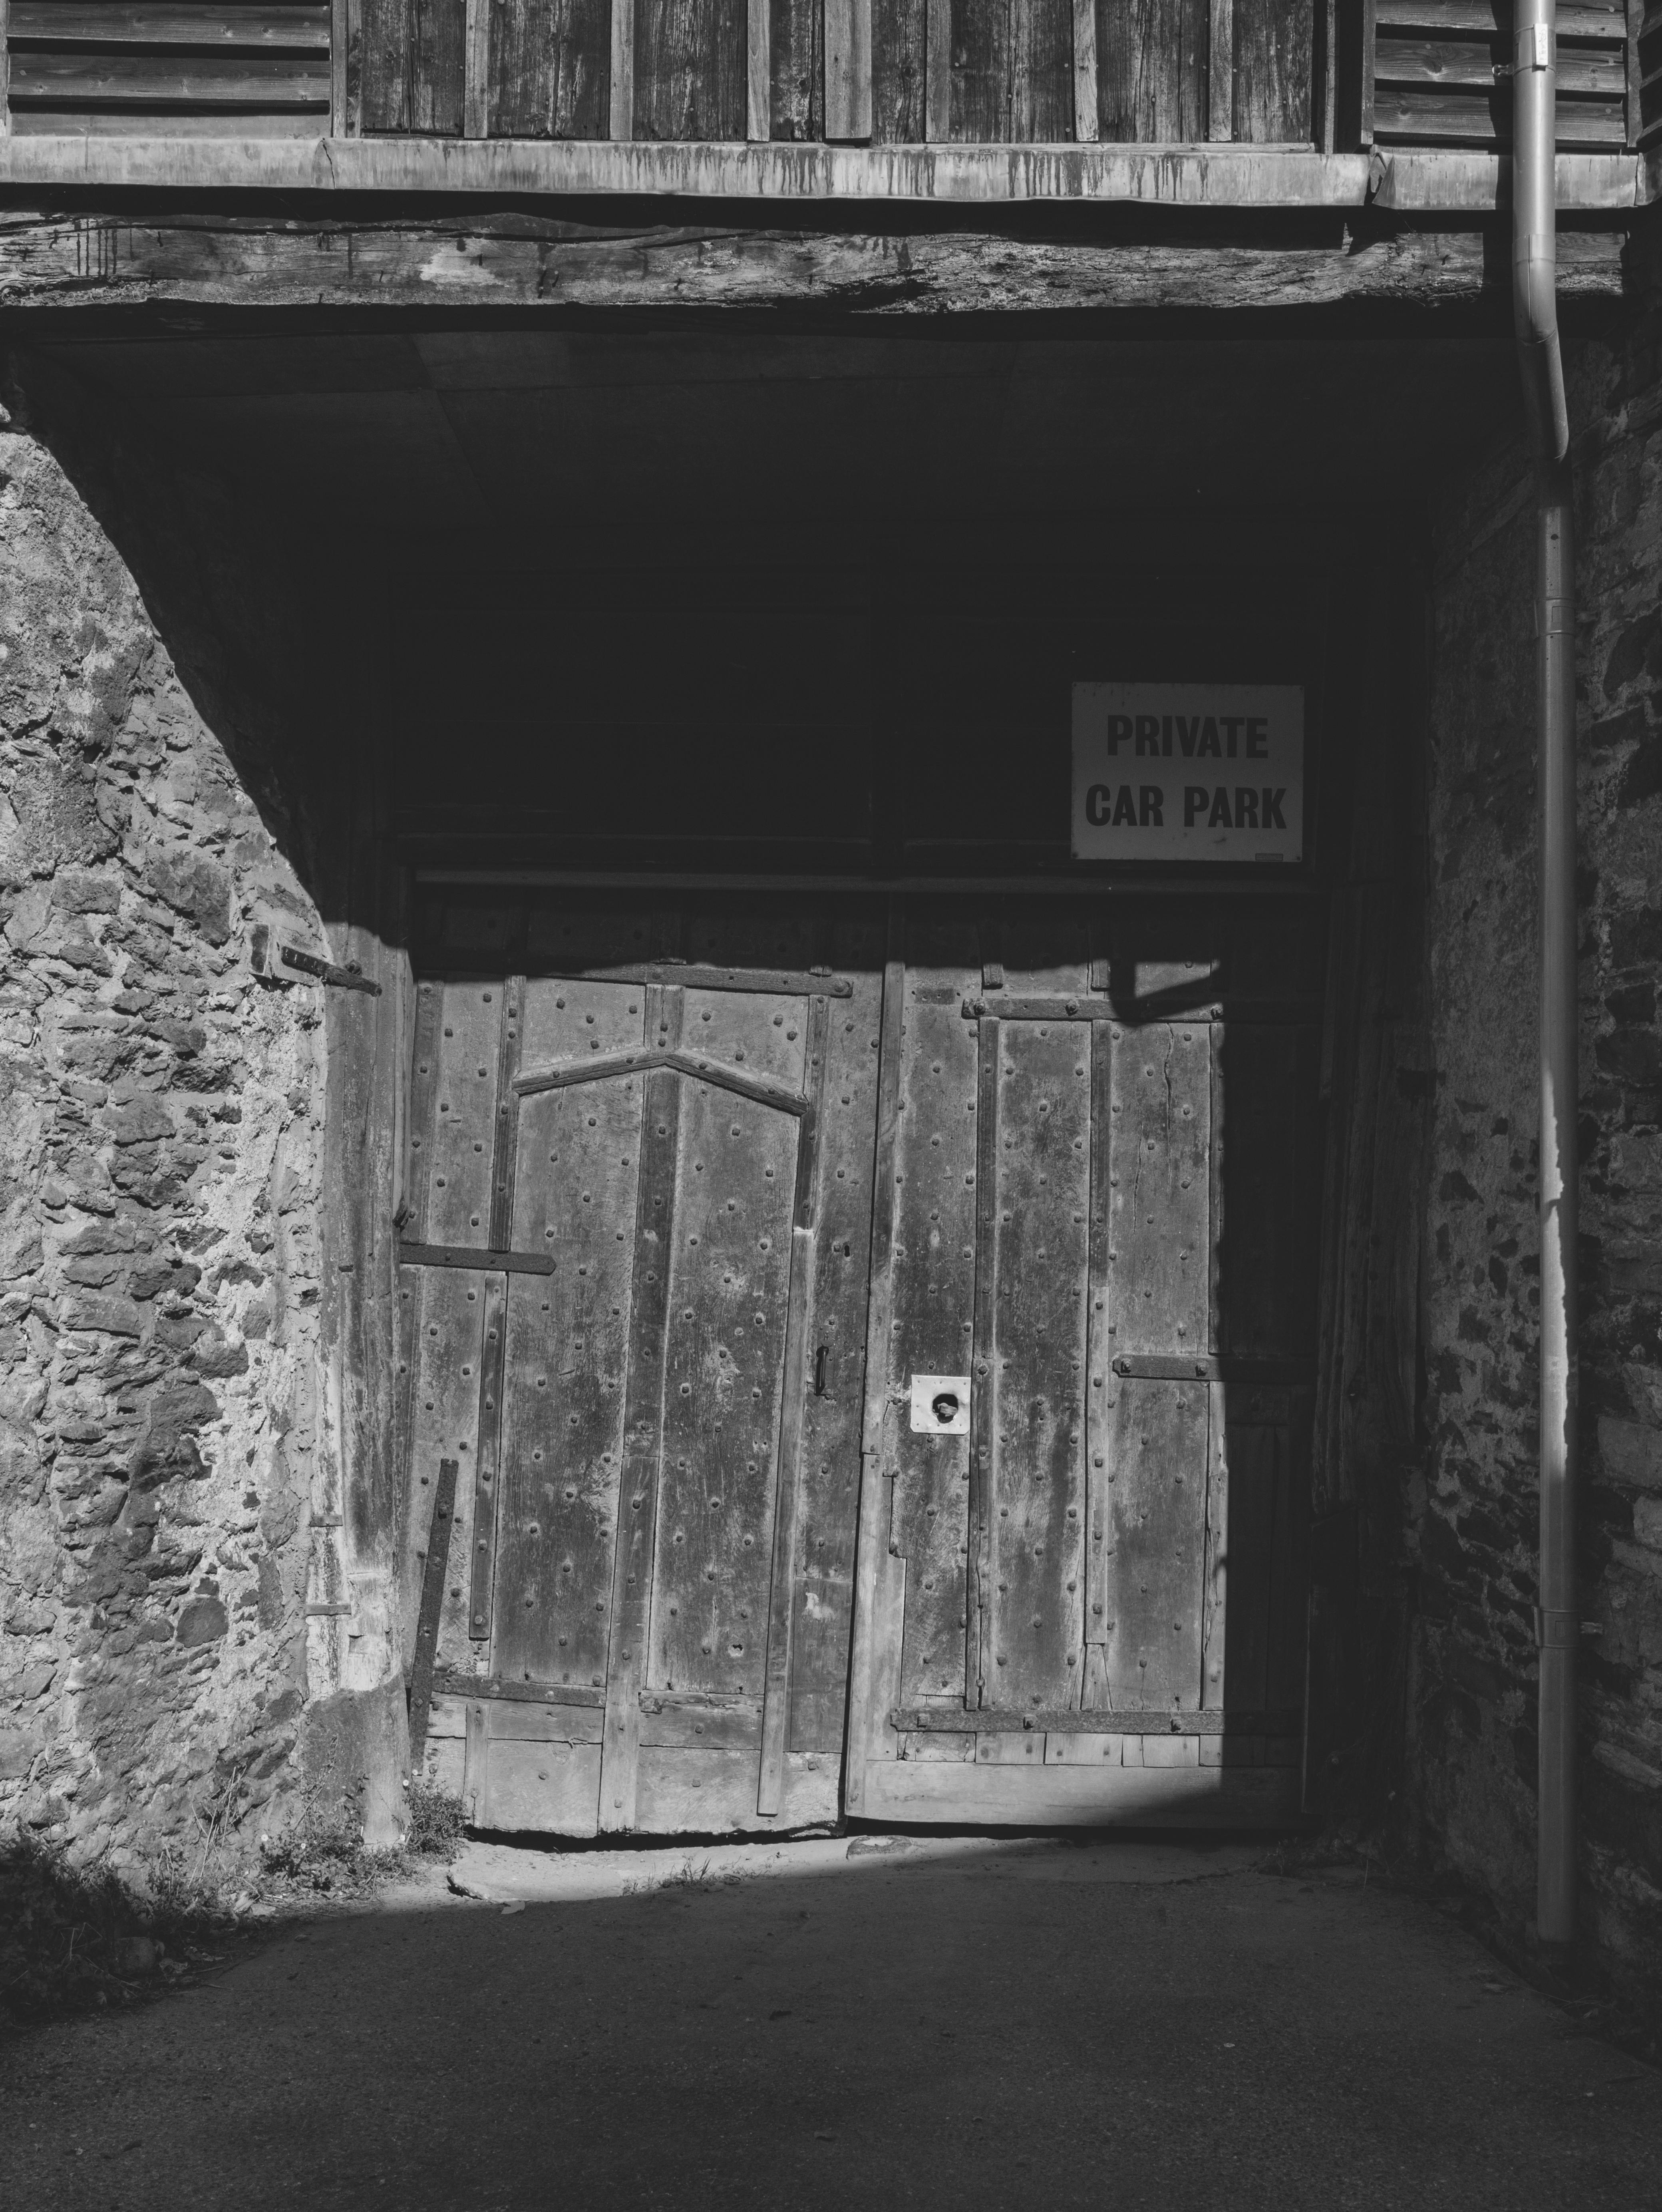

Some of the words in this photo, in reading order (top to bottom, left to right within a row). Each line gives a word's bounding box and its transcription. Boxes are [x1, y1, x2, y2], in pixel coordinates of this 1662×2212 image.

[1107, 714, 1268, 759] PRIVATE
[1085, 784, 1164, 827] CAR
[1184, 786, 1287, 829] PARK
